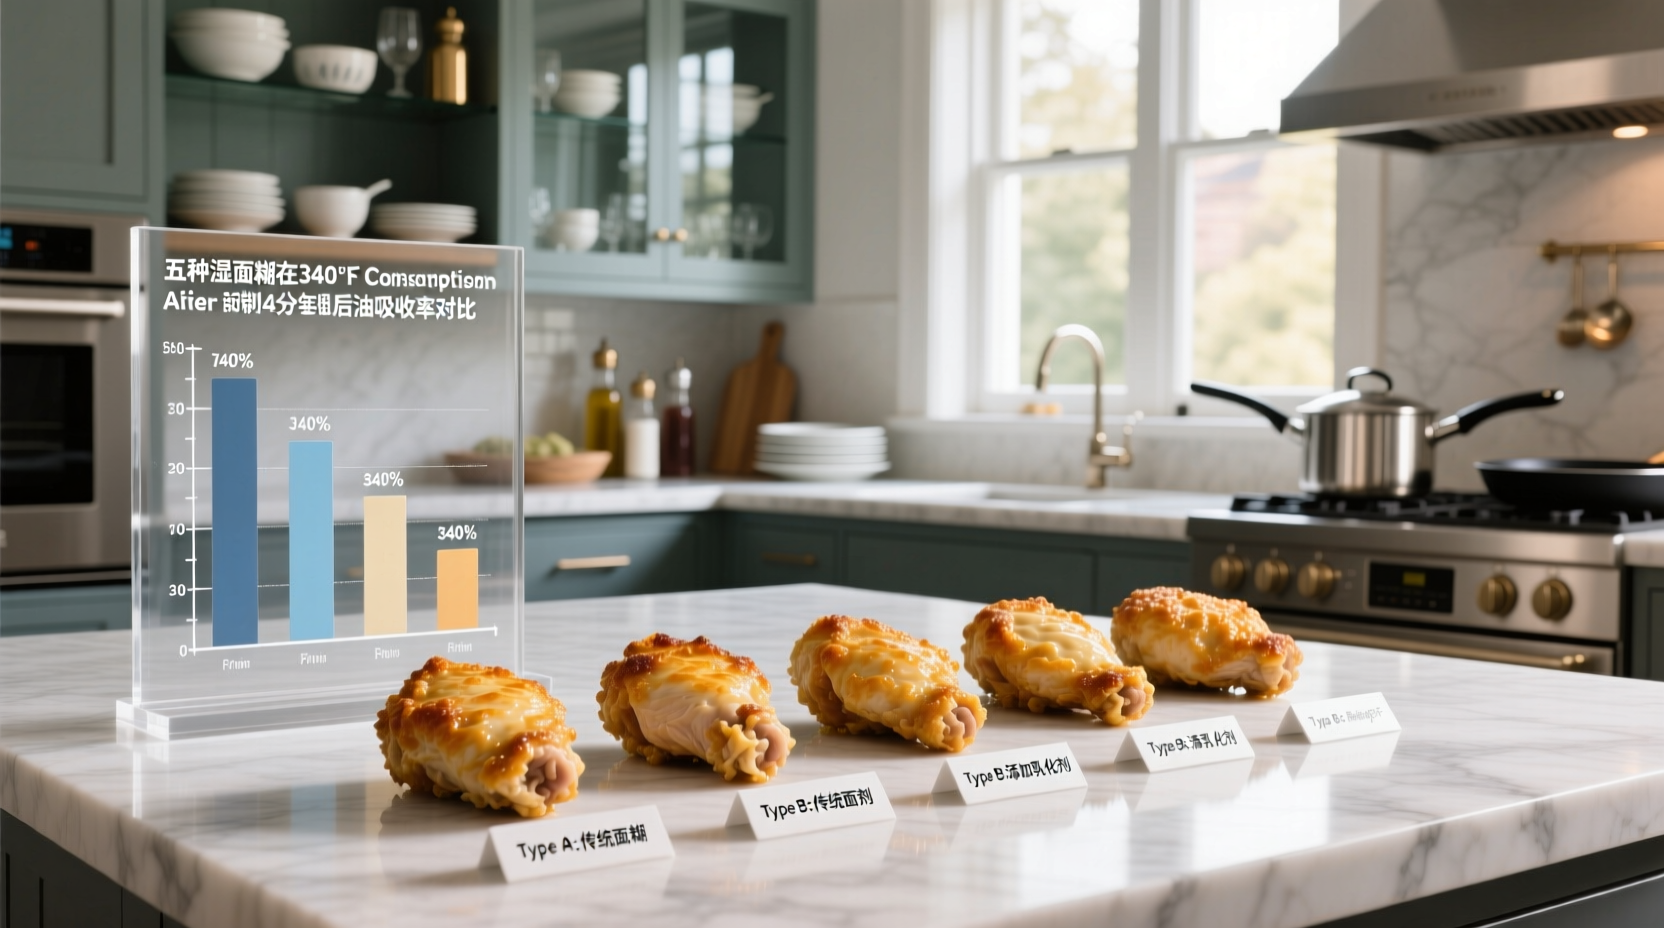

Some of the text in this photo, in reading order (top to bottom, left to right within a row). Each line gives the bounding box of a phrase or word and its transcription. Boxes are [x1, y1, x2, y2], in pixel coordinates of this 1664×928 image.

[211, 352, 254, 369] 740%
[168, 584, 186, 597] 30
[179, 644, 188, 657] 0
[963, 772, 993, 788] Type
[760, 804, 796, 822] Type
[516, 842, 558, 862] Type
